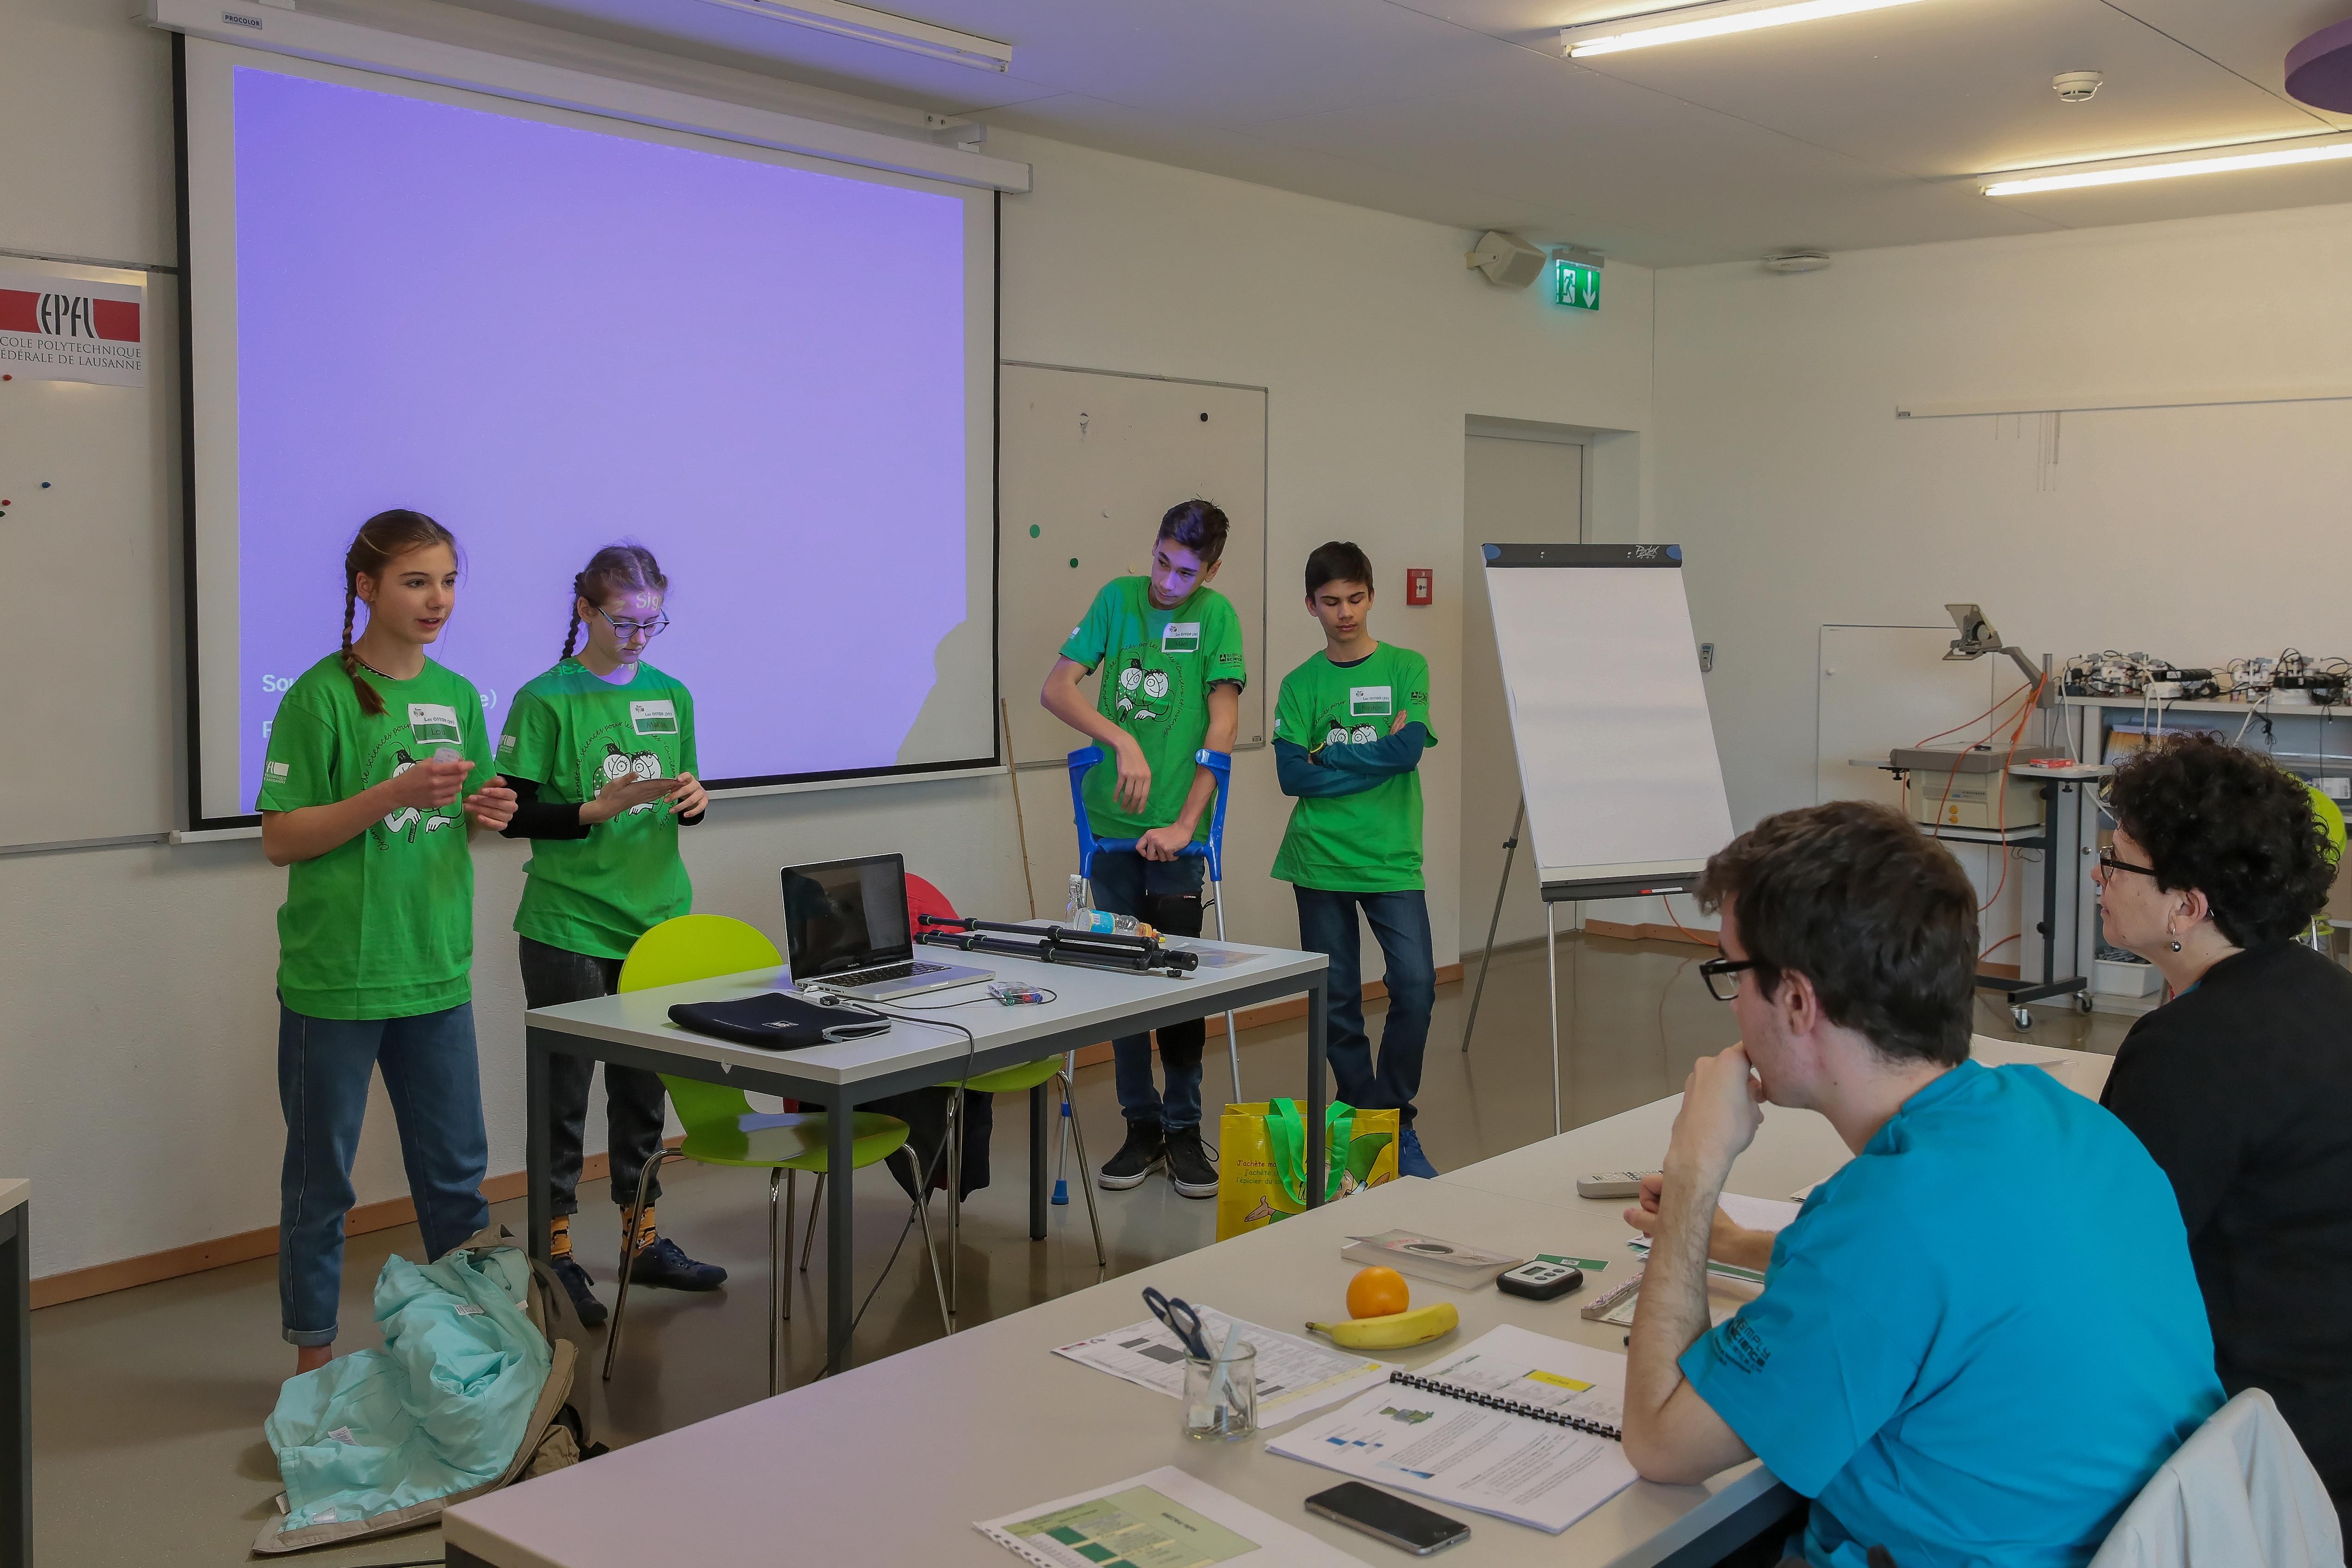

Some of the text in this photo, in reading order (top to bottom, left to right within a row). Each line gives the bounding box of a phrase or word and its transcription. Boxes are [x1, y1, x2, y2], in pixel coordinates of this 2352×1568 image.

[225, 15, 260, 26] PROCOLOR
[37, 339, 141, 359] POLYTECHNIQUE
[59, 354, 74, 365] DE
[79, 356, 141, 370] LAUSANNE
[1236, 1177, 1262, 1185] l'épicier
